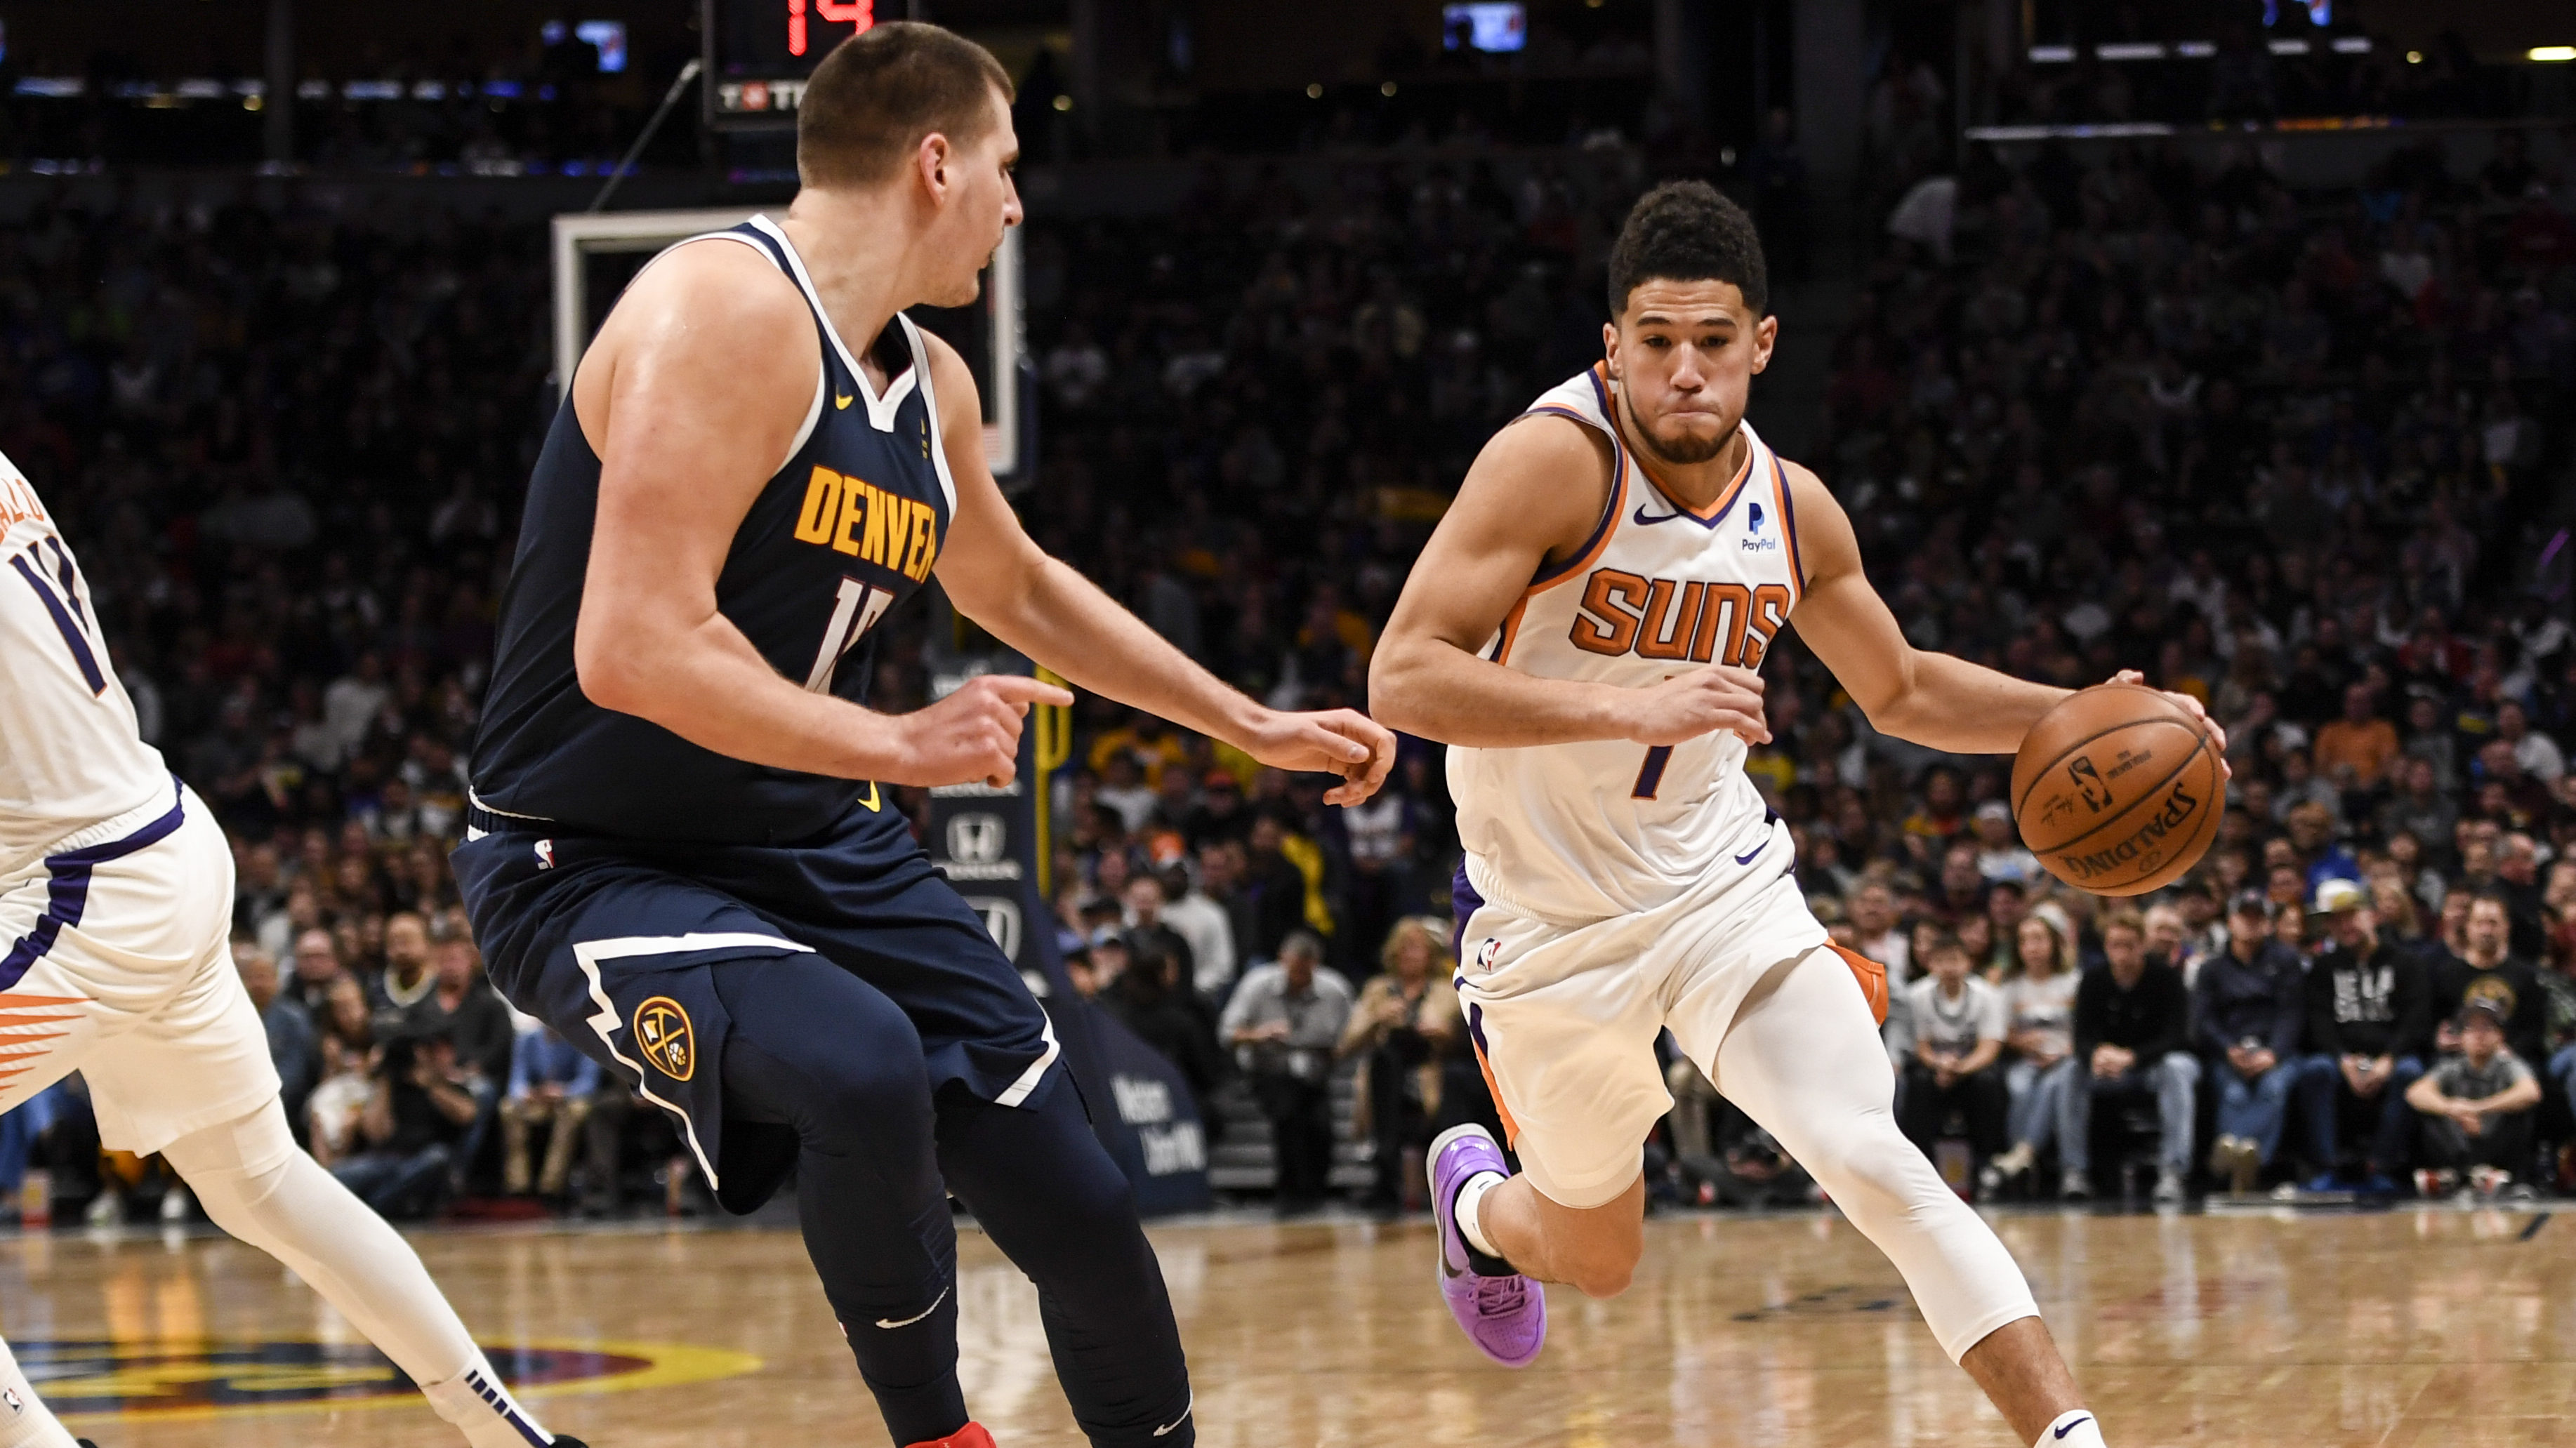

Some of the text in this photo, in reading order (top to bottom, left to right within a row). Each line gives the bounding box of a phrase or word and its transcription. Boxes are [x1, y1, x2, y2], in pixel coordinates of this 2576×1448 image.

[1742, 538, 1776, 552] PayPal
[1568, 567, 1790, 670] SUNS
[2059, 782, 2197, 878] SPALDING
